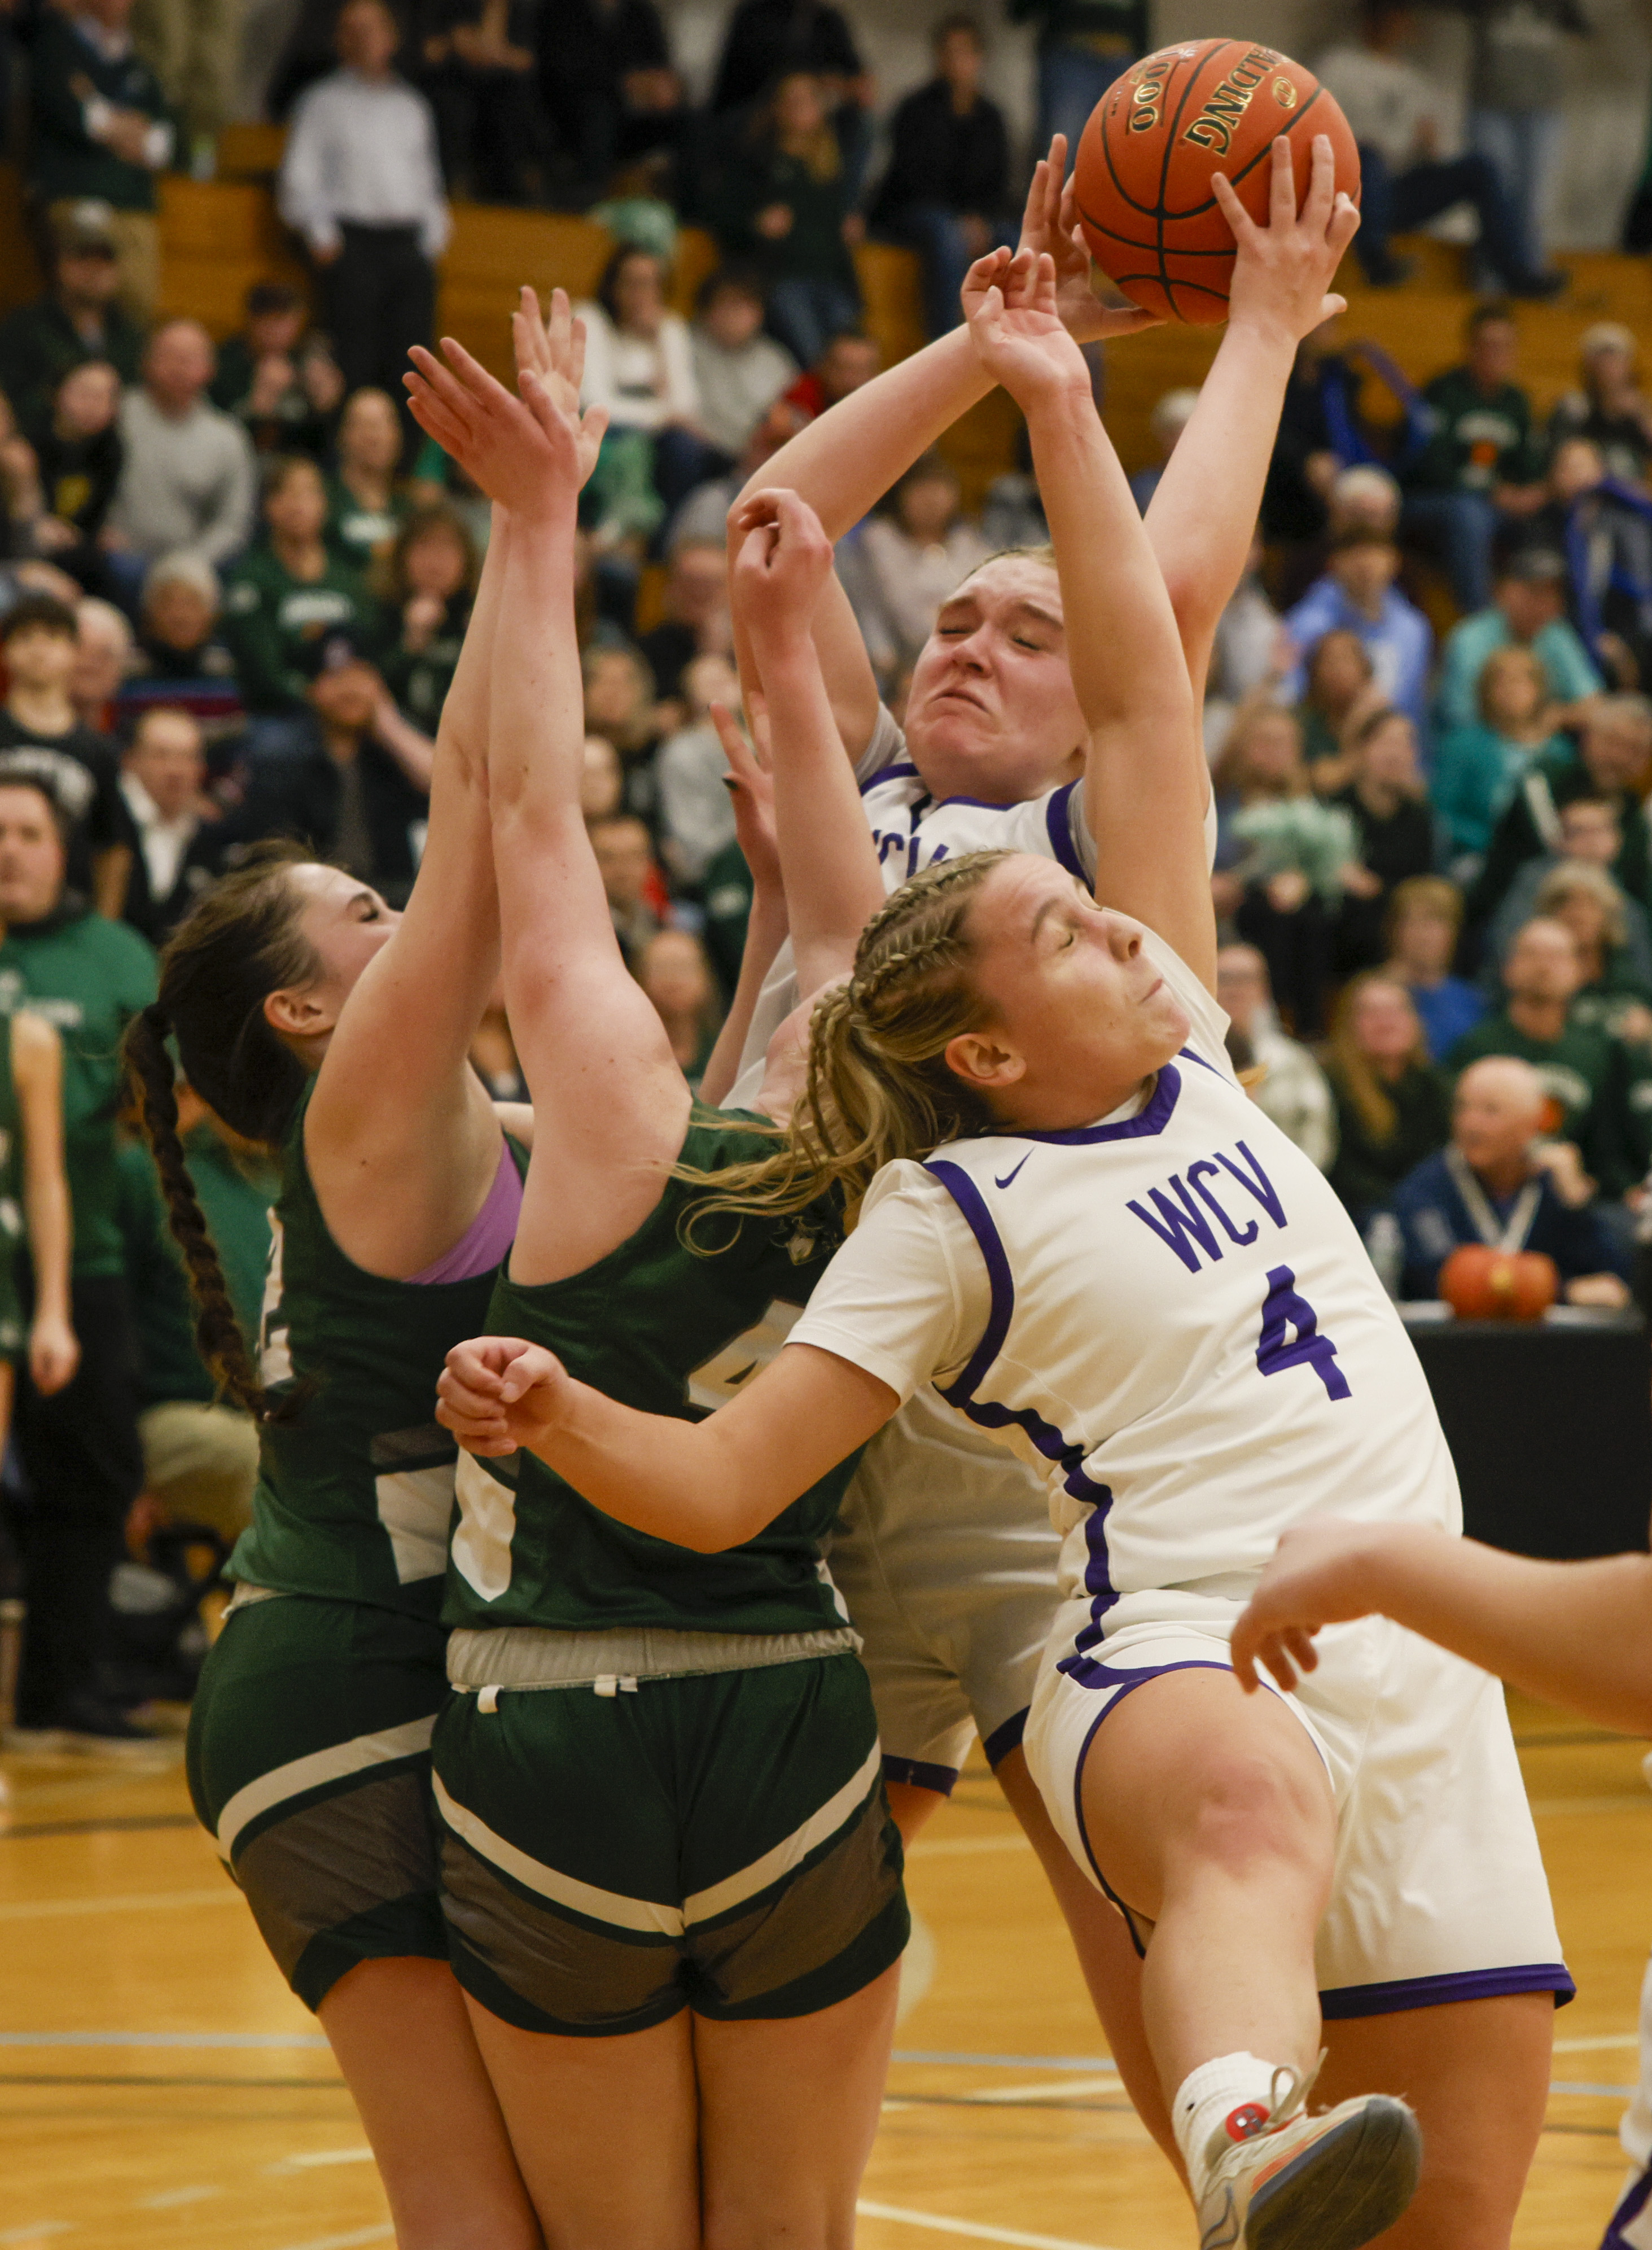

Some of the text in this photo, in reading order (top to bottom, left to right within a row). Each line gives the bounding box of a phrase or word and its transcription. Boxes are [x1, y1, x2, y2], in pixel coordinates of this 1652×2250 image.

[1129, 51, 1182, 133] 000
[1124, 1140, 1289, 1274] WCV
[1256, 1264, 1352, 1402] 4
